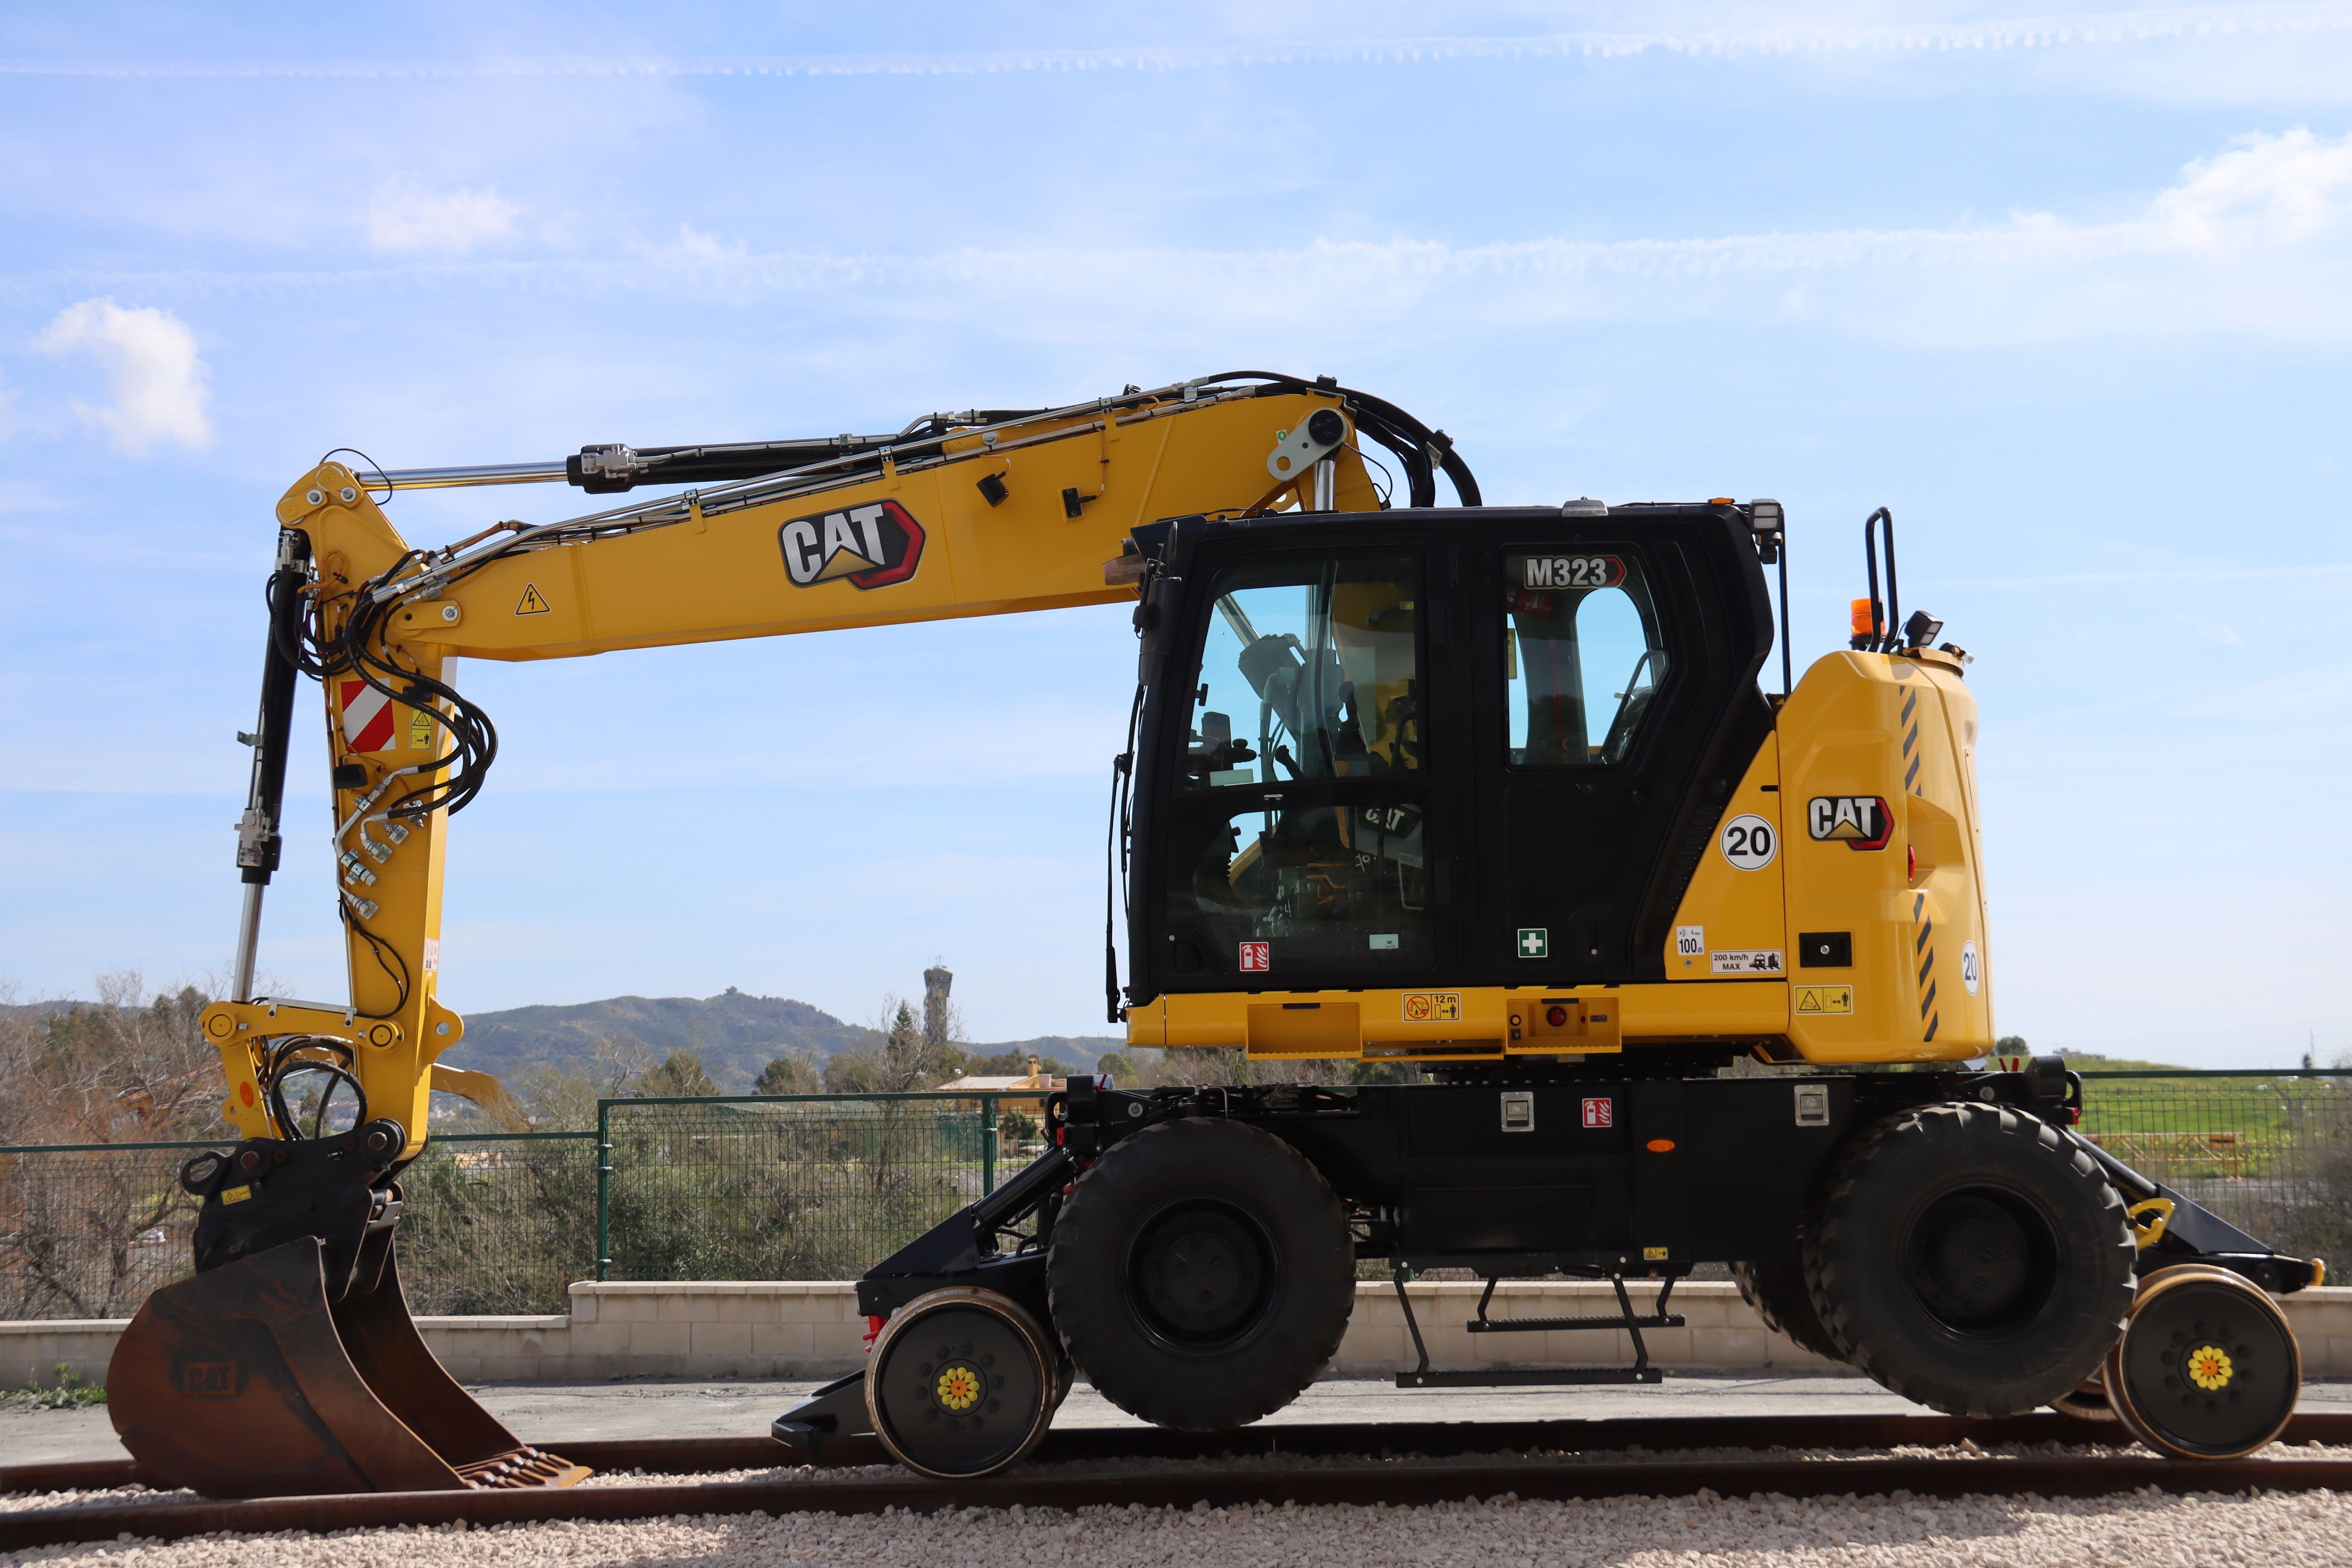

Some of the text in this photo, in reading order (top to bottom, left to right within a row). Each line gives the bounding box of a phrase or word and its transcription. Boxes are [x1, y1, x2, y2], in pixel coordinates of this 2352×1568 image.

[782, 503, 884, 583] CAT
[1527, 558, 1607, 586] M323
[1809, 798, 1876, 838] CAT
[1727, 826, 1770, 856] 20
[1679, 938, 1697, 953] 100
[1964, 952, 1977, 981] 20
[1435, 995, 1445, 1004] 12
[190, 1367, 232, 1391] CAT
